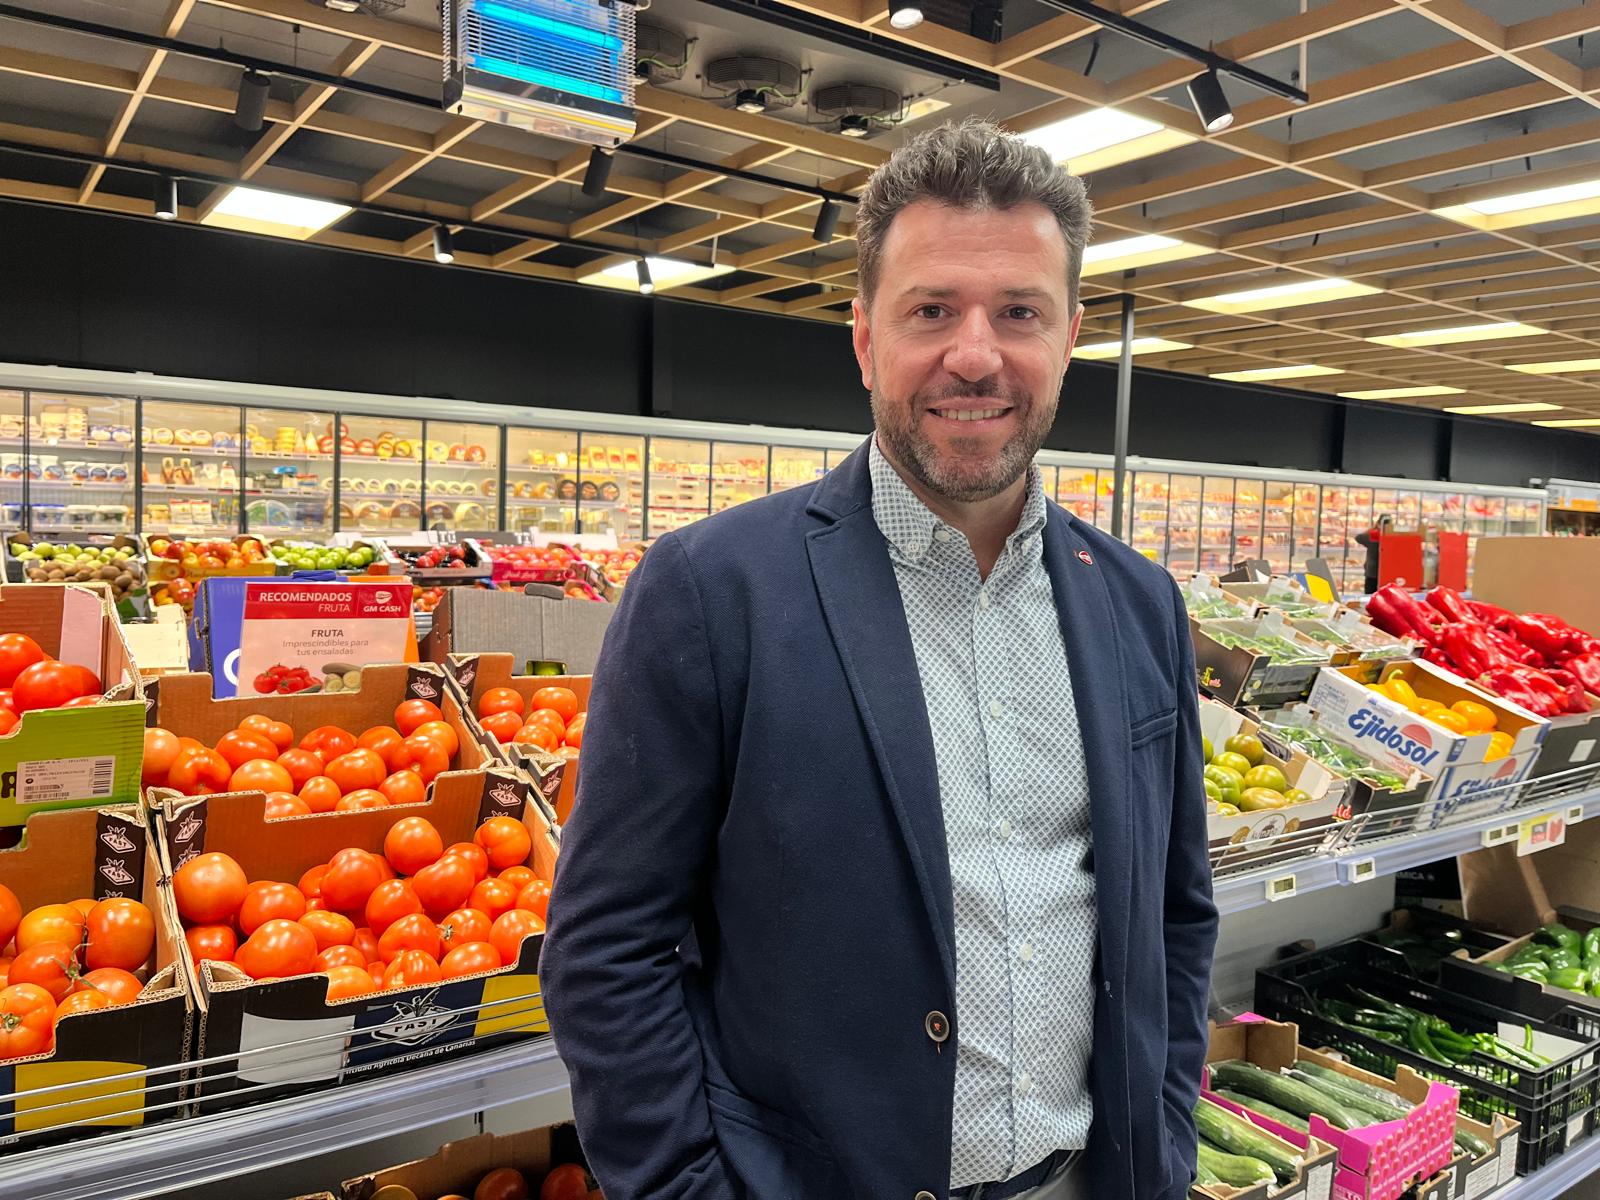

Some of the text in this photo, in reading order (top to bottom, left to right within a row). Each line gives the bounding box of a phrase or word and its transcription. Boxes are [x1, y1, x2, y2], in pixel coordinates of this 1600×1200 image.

[259, 592, 352, 602] RECOMENDADOS
[318, 603, 351, 613] FRUTA
[379, 605, 402, 613] CASH
[311, 629, 344, 638] FRUTA
[282, 639, 369, 649] Imprescindibles para
[312, 648, 354, 656] ensaladas
[1348, 708, 1440, 767] Ejidosol
[107, 836, 128, 848] FAST
[107, 868, 127, 880] FAST
[394, 1018, 438, 1033] FAST
[434, 1046, 444, 1054] de
[445, 1040, 476, 1053] Canarias
